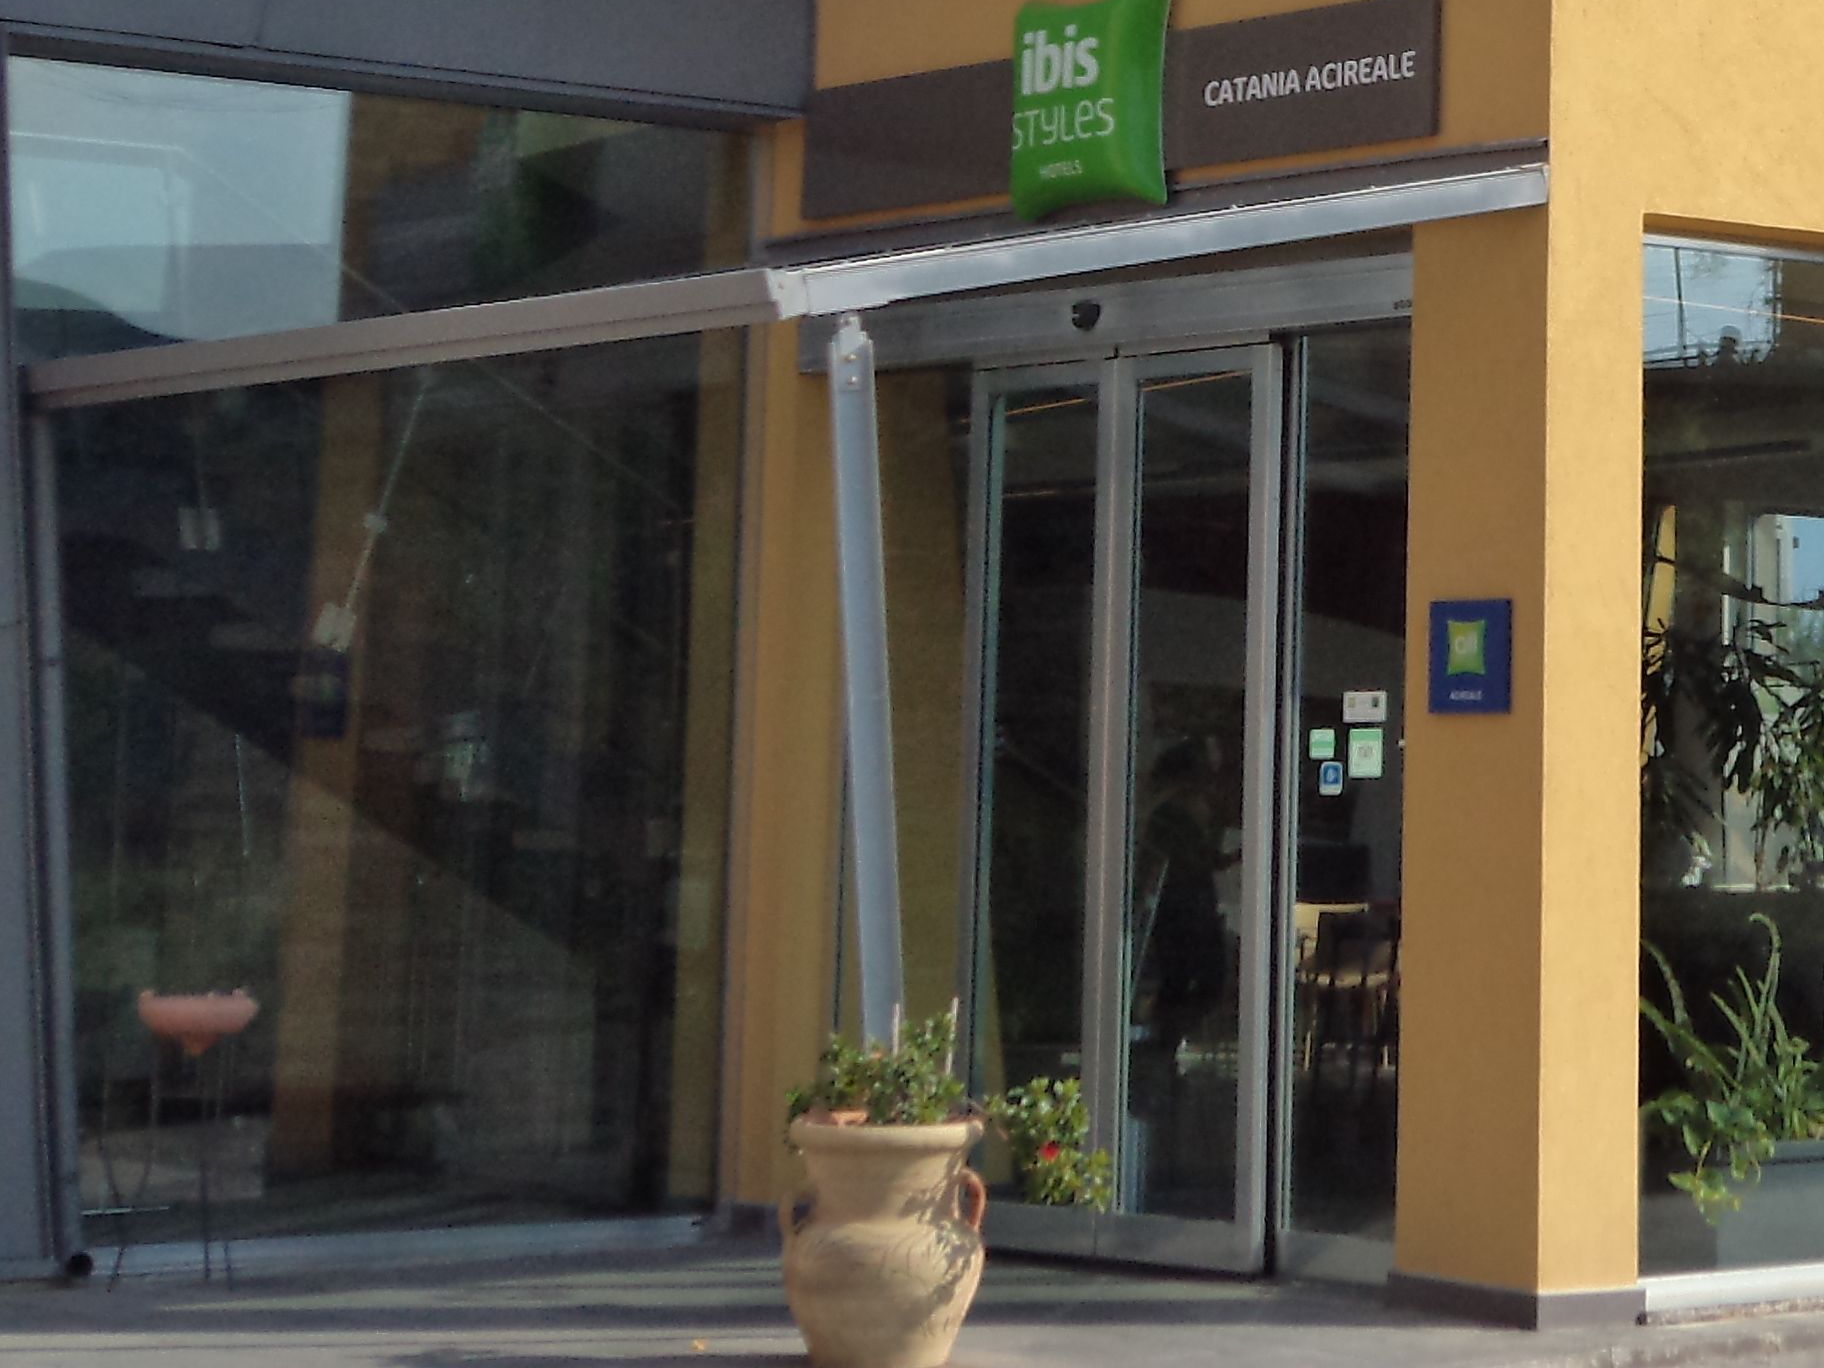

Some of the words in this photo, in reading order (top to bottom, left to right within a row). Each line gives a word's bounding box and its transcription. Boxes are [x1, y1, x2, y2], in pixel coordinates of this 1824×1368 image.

[1021, 24, 1099, 95] ibis
[1204, 69, 1301, 107] CATANIA
[1305, 50, 1416, 92] ACIREALE
